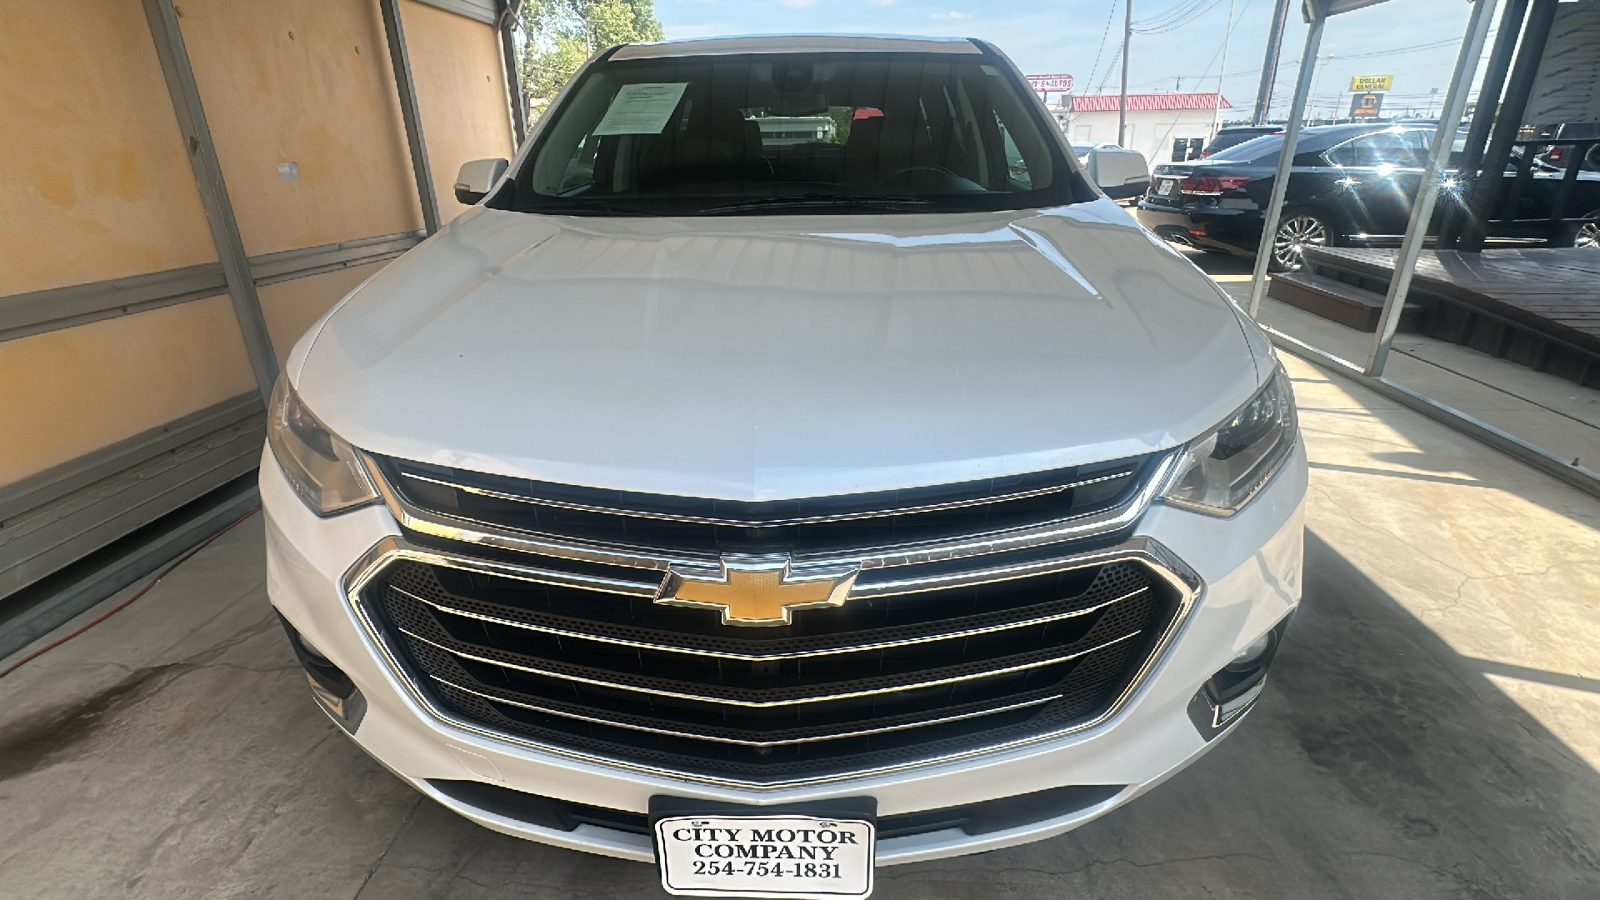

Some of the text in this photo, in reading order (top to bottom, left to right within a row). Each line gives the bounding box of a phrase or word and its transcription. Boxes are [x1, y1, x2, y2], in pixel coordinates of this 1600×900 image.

[1050, 79, 1072, 87] AUTOS
[672, 828, 859, 845] CITY MOTOR
[694, 843, 839, 861] COMPANY
[692, 861, 842, 879] 254-754-1831
